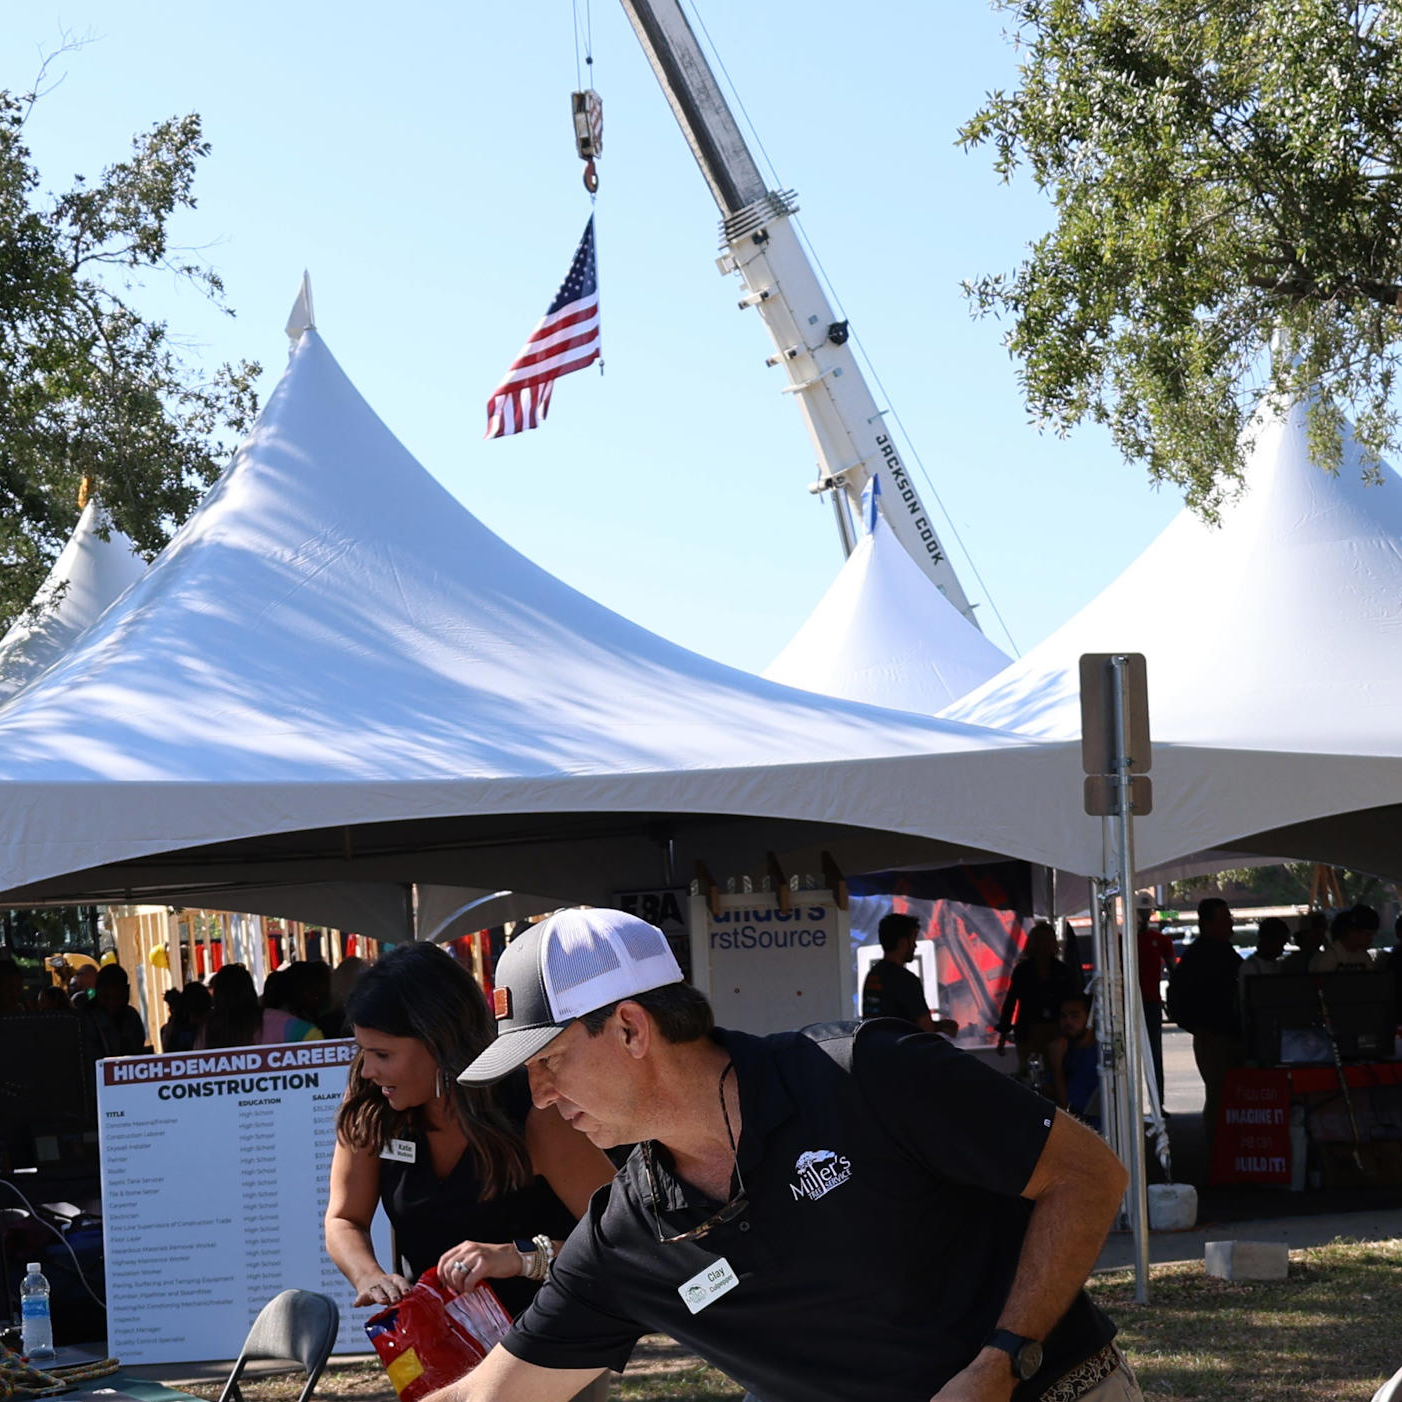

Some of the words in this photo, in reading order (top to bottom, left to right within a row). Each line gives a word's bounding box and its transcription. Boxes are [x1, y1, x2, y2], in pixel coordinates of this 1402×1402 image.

[875, 434, 920, 515] JACKSON
[915, 517, 944, 566] COOK
[113, 1053, 264, 1082] HIGH-DEMAND
[158, 1072, 320, 1100] CONSTRUCTION
[106, 1110, 125, 1118] TITLE
[238, 1097, 281, 1107] EDUCATION
[312, 1092, 342, 1101] SALARY
[1226, 1108, 1273, 1126] IMAGINE
[789, 1155, 851, 1200] Miller's
[1234, 1156, 1268, 1174] BUILD
[808, 1187, 824, 1200] TREE
[825, 1169, 852, 1189] SERVICE
[707, 1267, 726, 1282] Clay
[709, 1274, 734, 1293] Culpepper
